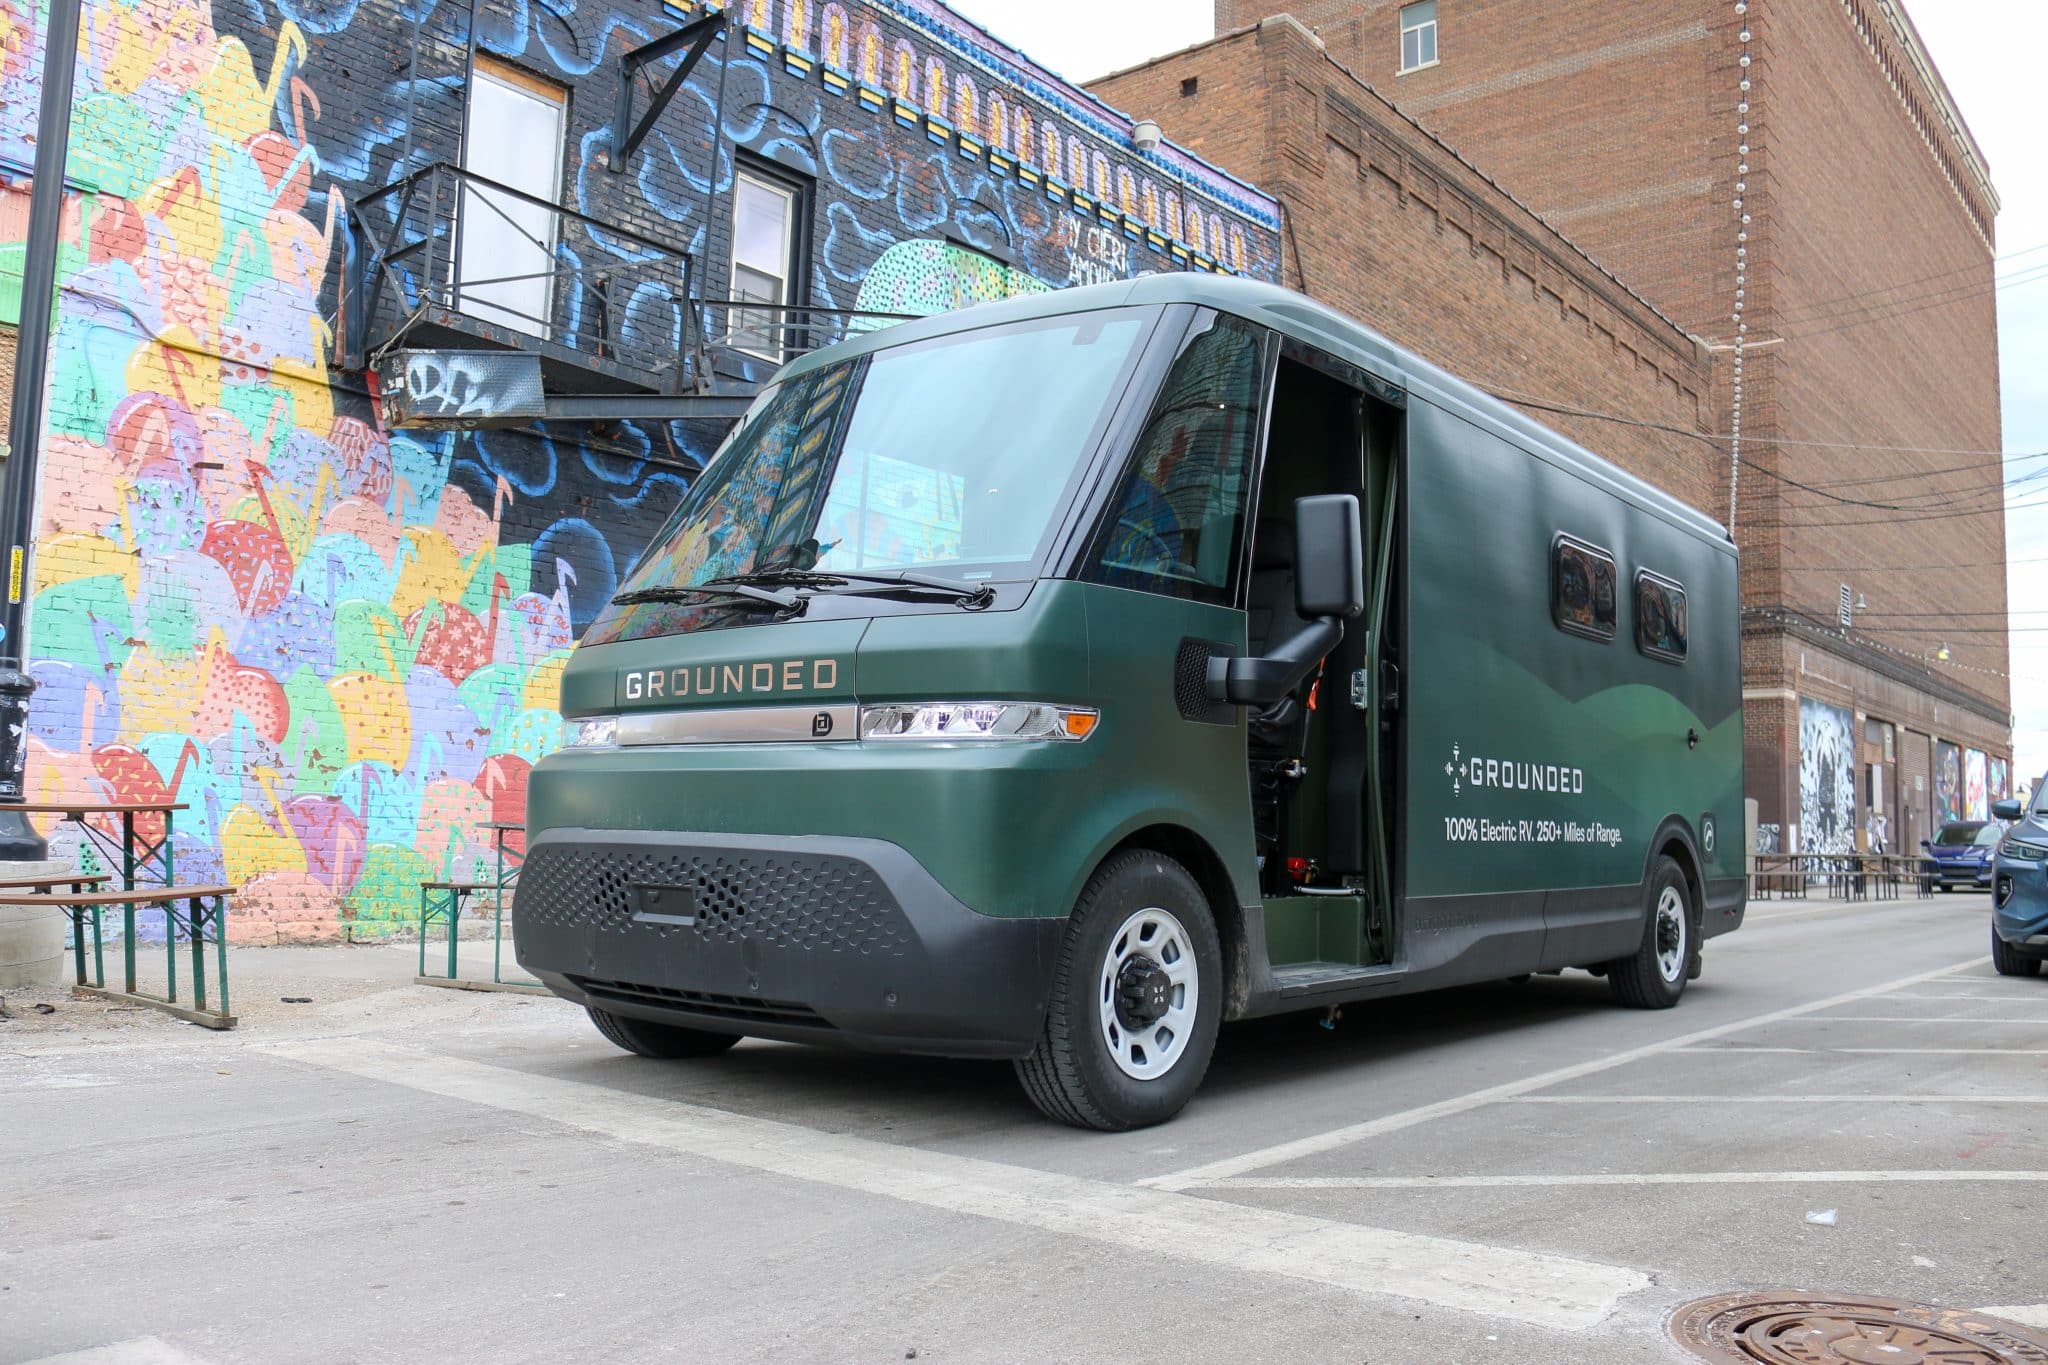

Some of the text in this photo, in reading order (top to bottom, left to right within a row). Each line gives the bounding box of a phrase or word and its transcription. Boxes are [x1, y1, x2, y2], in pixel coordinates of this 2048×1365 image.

[626, 659, 837, 699] GROUNDED
[1470, 757, 1583, 794] GROUNDED
[1445, 817, 1622, 848] 100% Electric RV. 250+ Miles of Range.
